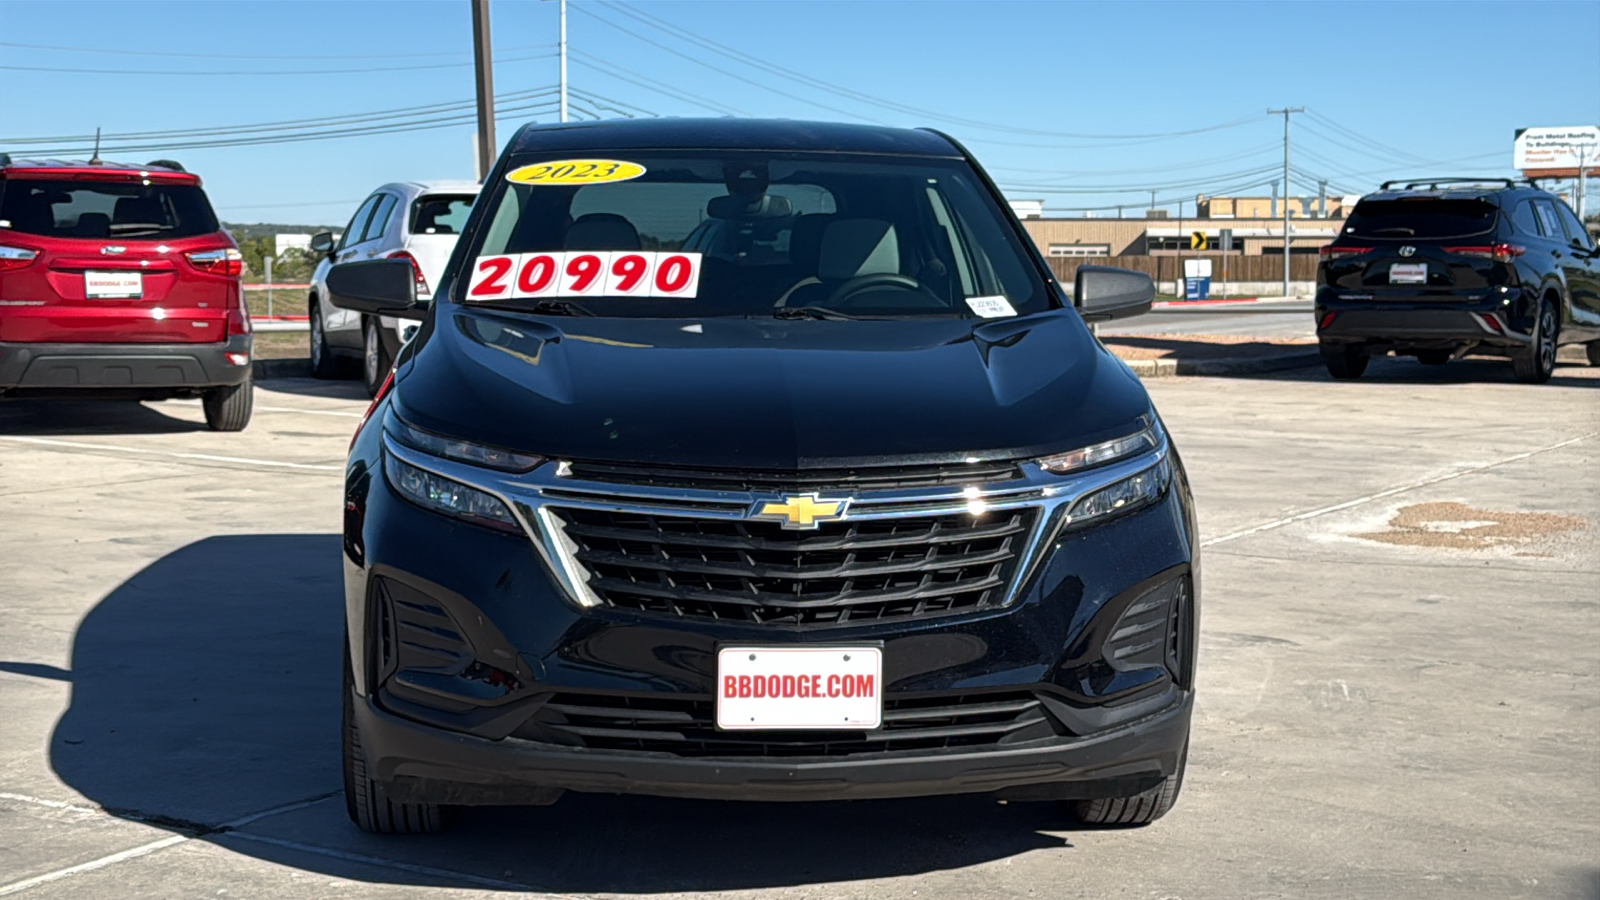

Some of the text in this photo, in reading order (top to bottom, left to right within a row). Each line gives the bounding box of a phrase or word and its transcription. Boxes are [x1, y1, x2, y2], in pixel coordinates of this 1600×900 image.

[526, 163, 621, 181] 2023
[470, 254, 695, 297] 20990
[723, 674, 874, 698] BBDODGE.COM
